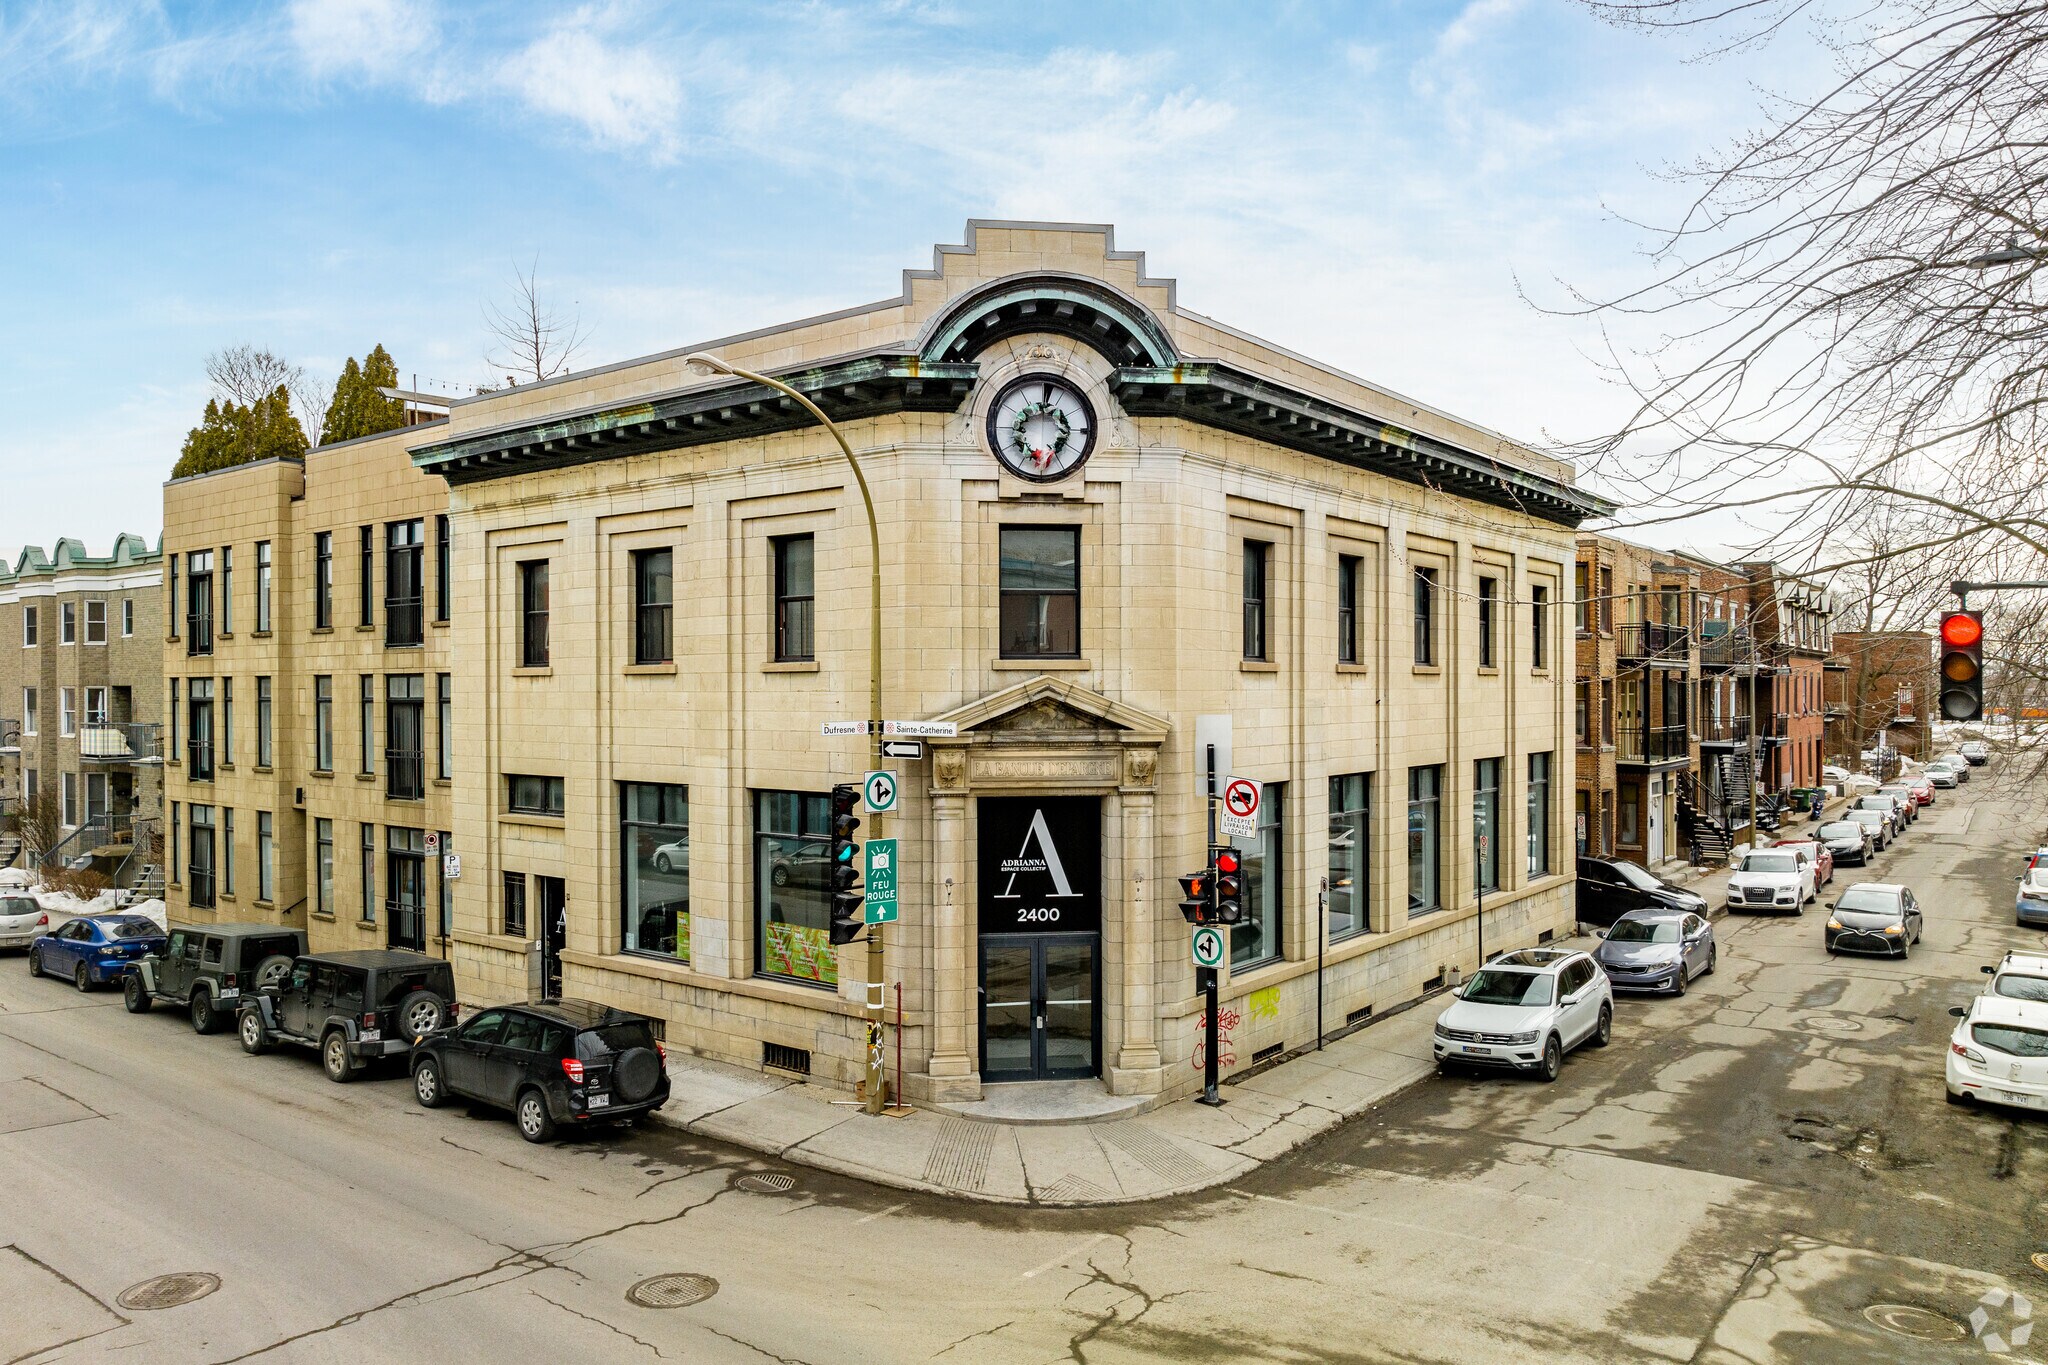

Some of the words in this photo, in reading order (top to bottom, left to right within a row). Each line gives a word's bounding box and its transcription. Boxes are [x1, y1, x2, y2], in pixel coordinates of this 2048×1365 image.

[824, 726, 855, 734] Dufresne
[896, 725, 953, 734] Sainte-Catherine
[975, 761, 993, 776] LA
[1001, 859, 1046, 867] ADRIANNA
[873, 880, 889, 890] FEU
[867, 890, 895, 901] ROUGE
[1017, 908, 1060, 922] 2400
